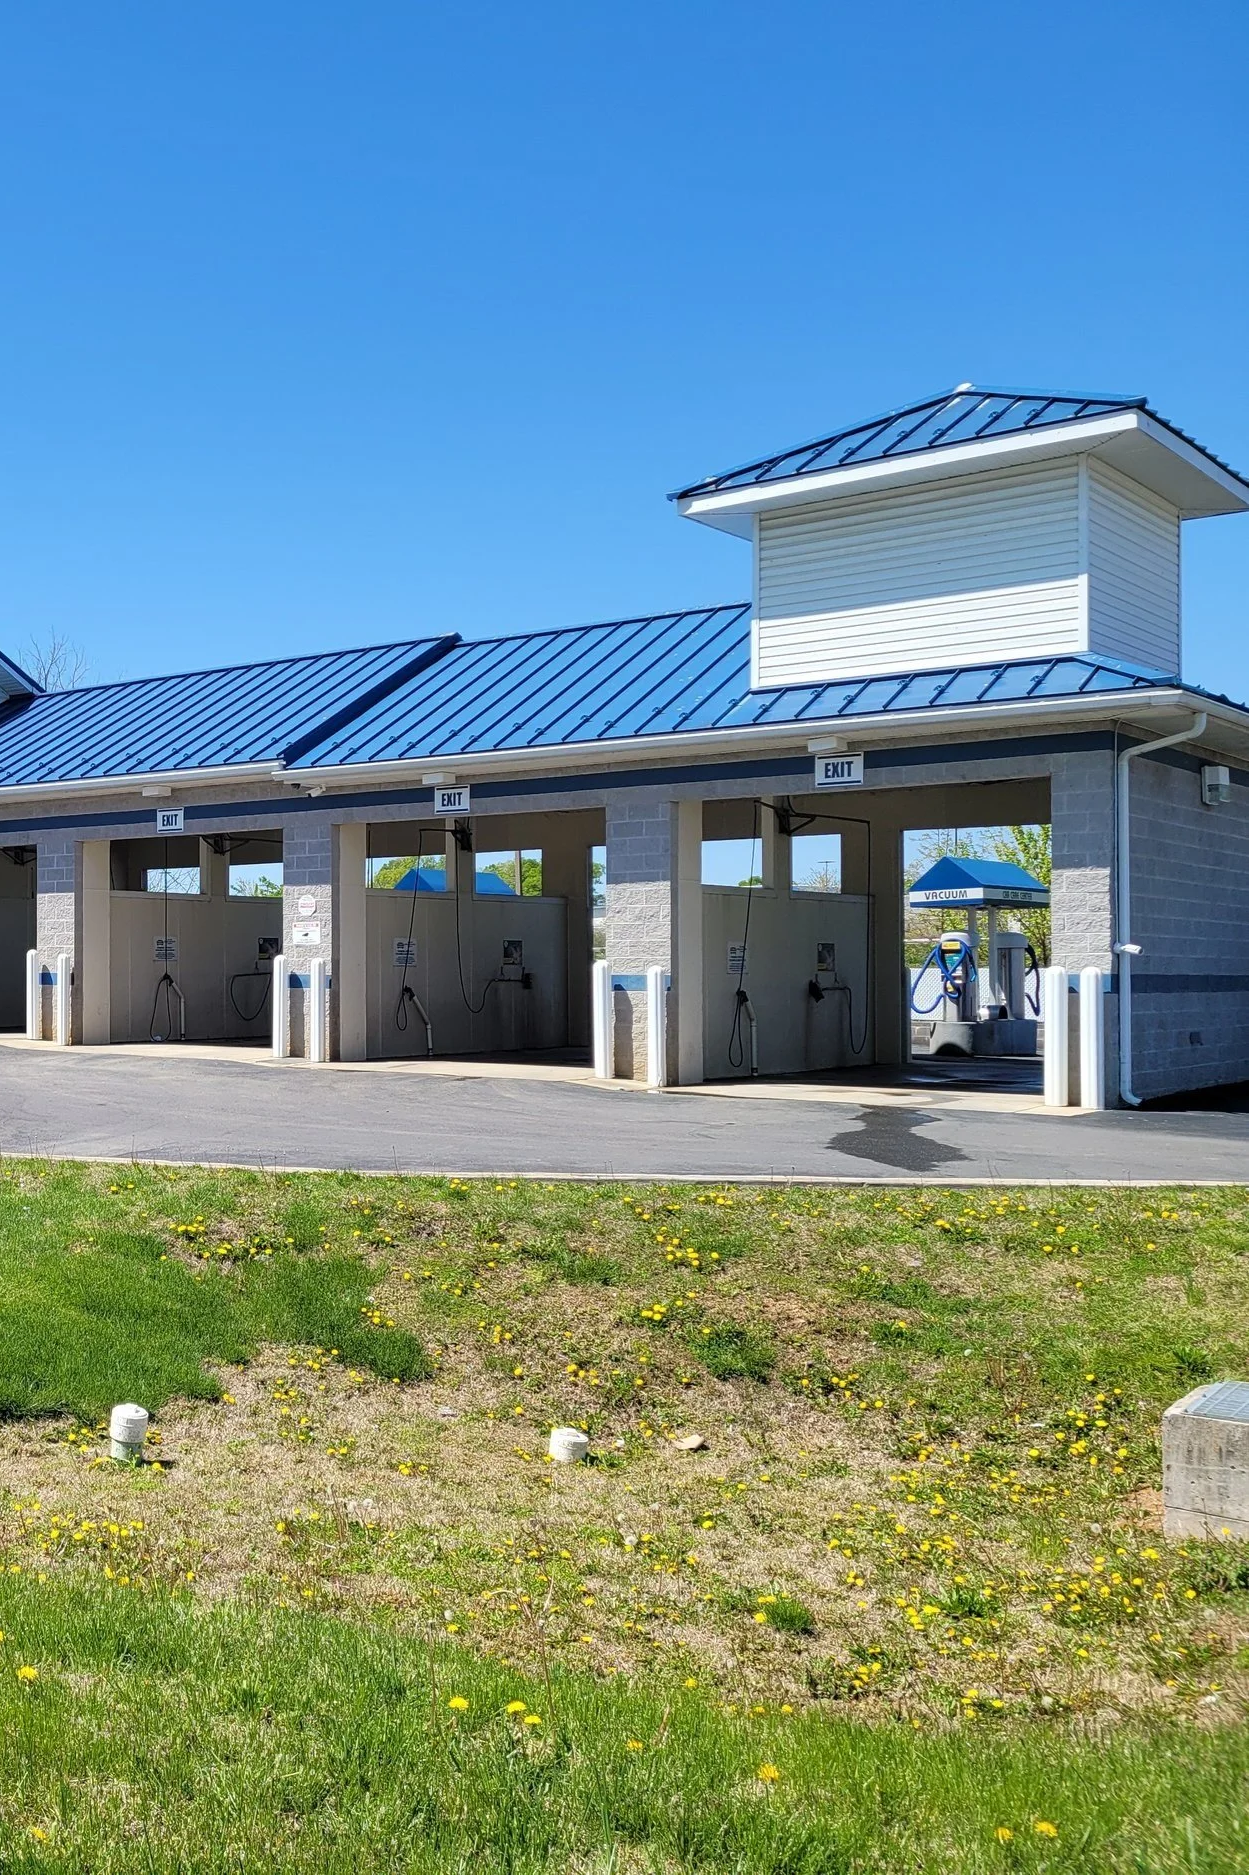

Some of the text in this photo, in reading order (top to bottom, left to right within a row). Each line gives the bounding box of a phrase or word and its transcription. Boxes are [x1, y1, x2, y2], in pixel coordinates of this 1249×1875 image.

[824, 760, 854, 779] EXIT
[441, 791, 463, 807] EXIT
[161, 813, 178, 827] EXIT
[924, 889, 968, 900] VACUUM
